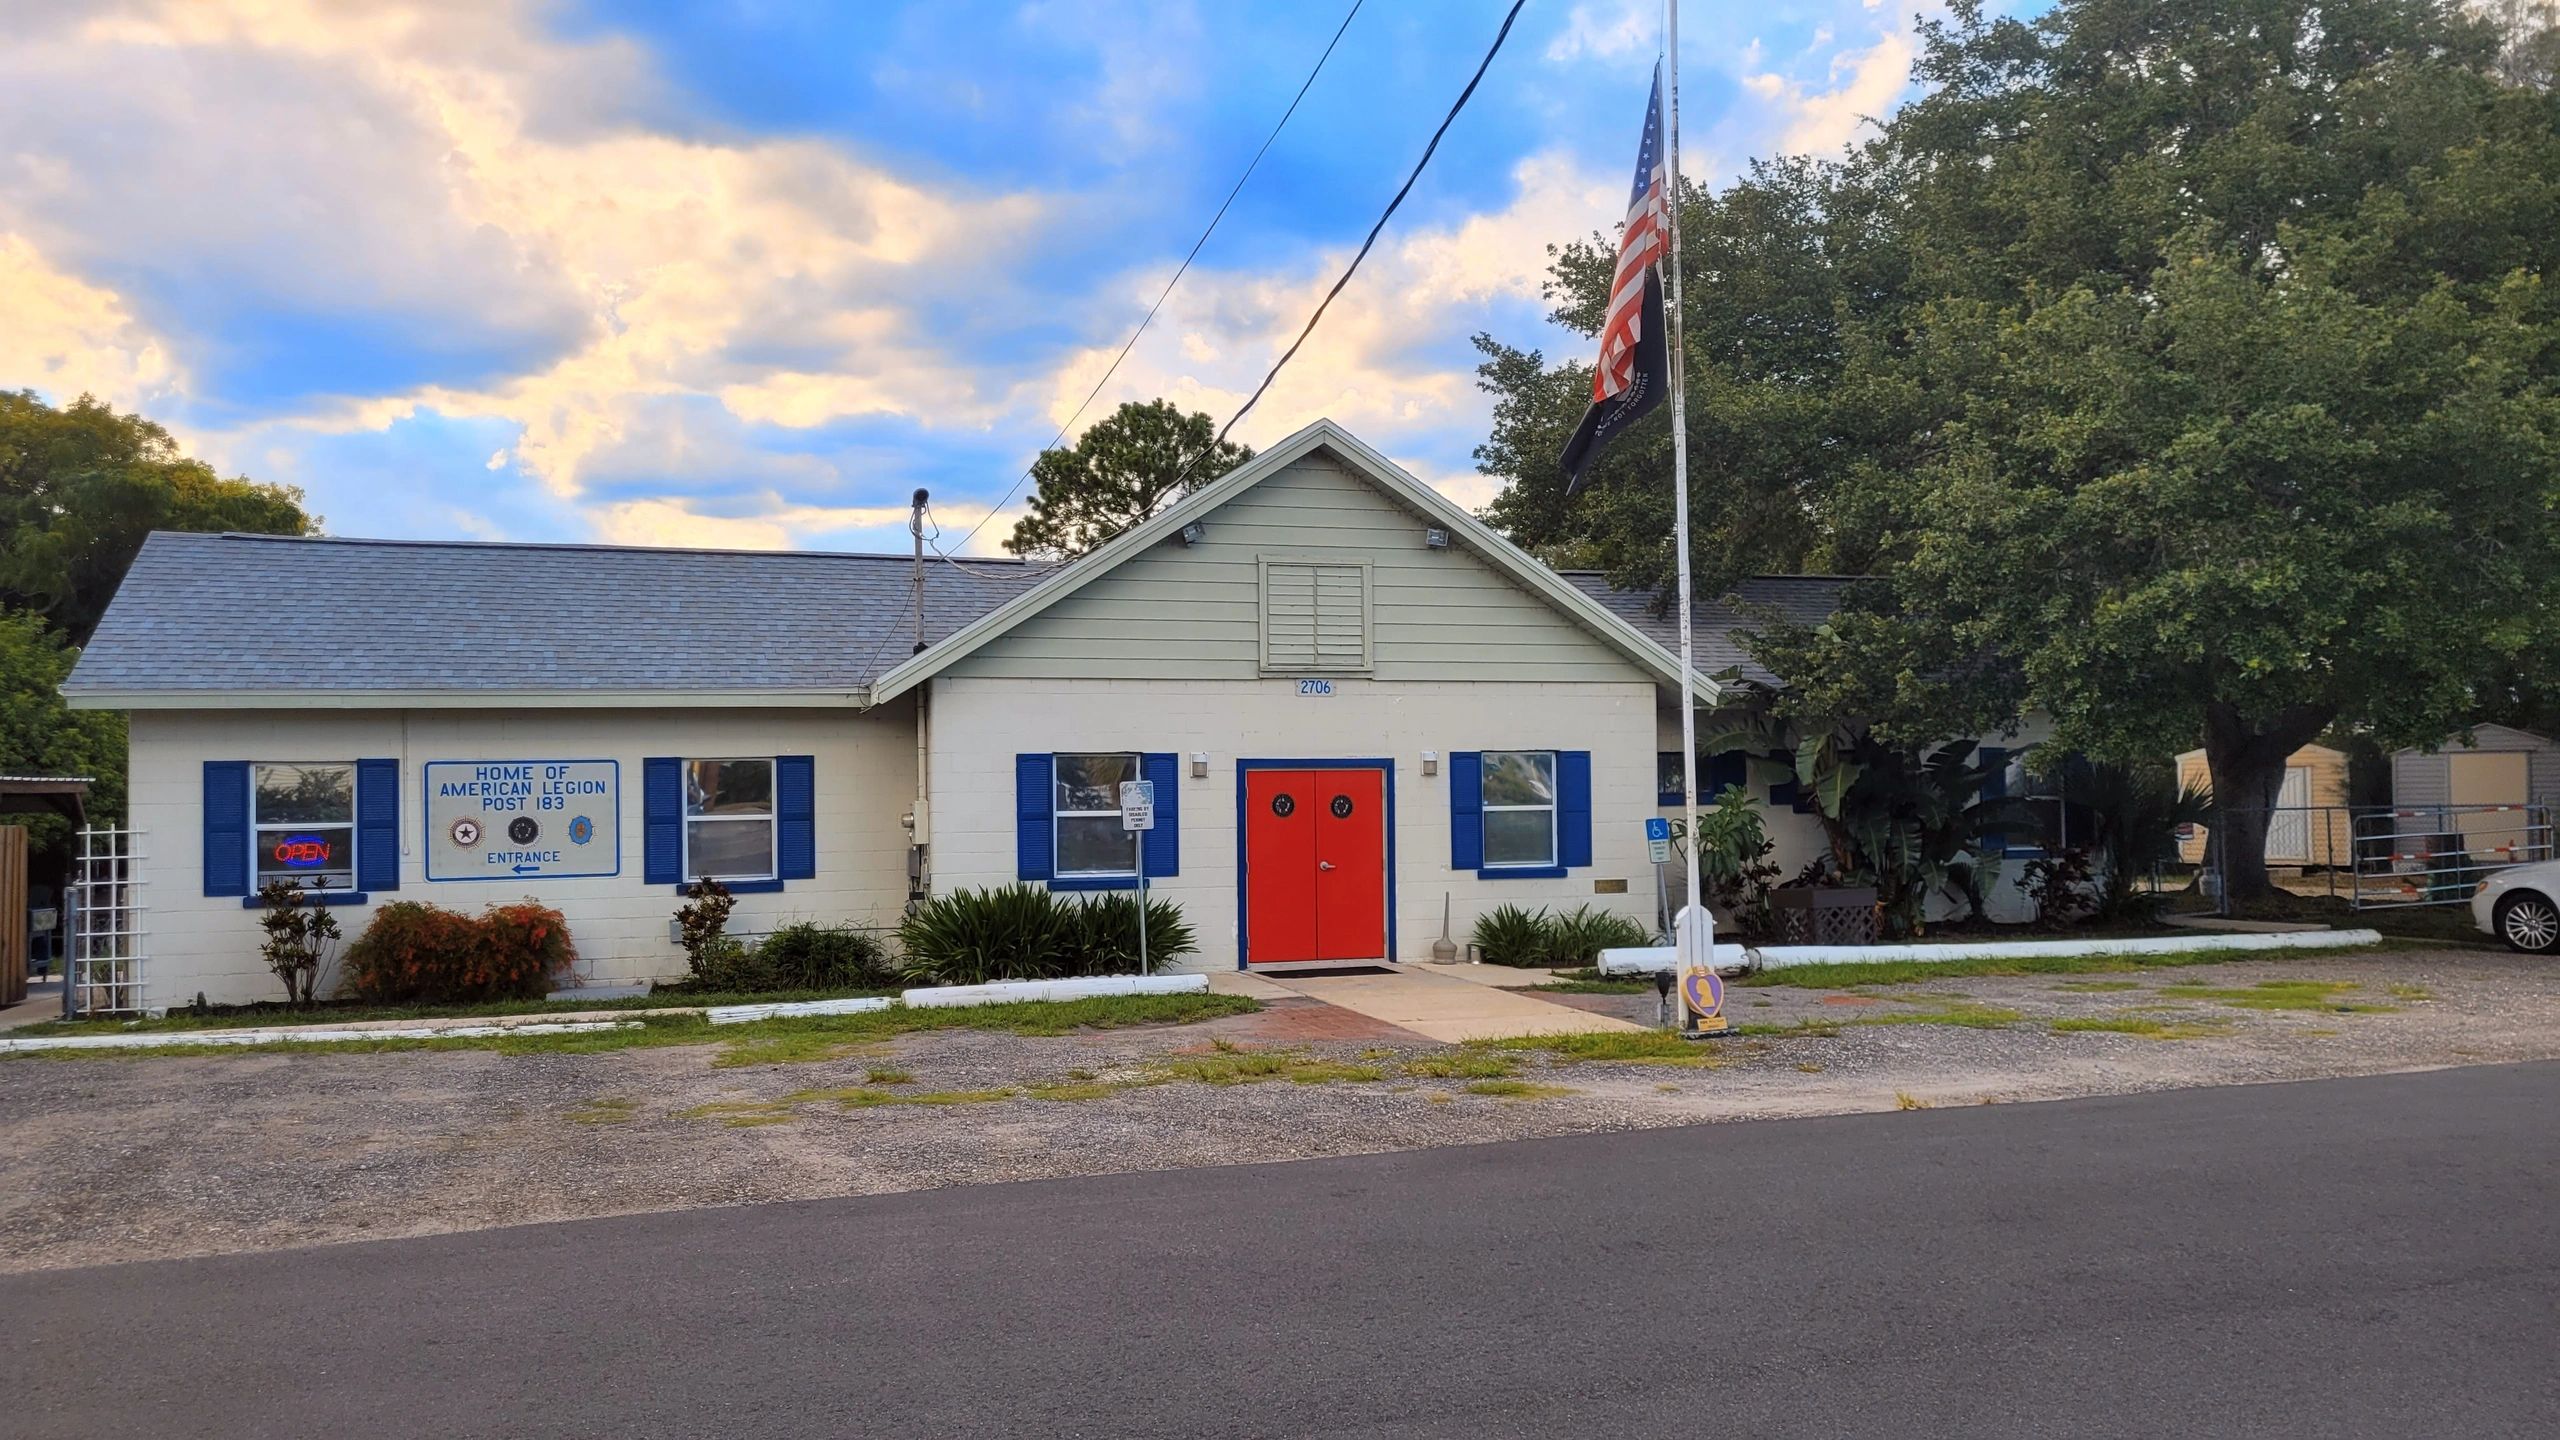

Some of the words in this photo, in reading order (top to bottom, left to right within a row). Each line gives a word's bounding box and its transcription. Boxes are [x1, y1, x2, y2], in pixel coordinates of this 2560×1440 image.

[1301, 680, 1331, 694] 2706
[476, 766, 534, 781] HOME
[545, 766, 570, 780] OF
[440, 781, 532, 797] AMERICAN
[542, 780, 606, 795] LEGION
[482, 797, 527, 812] POST
[536, 796, 565, 811] 183
[275, 843, 330, 862] OPEN
[487, 851, 561, 864] ENTRANCE
